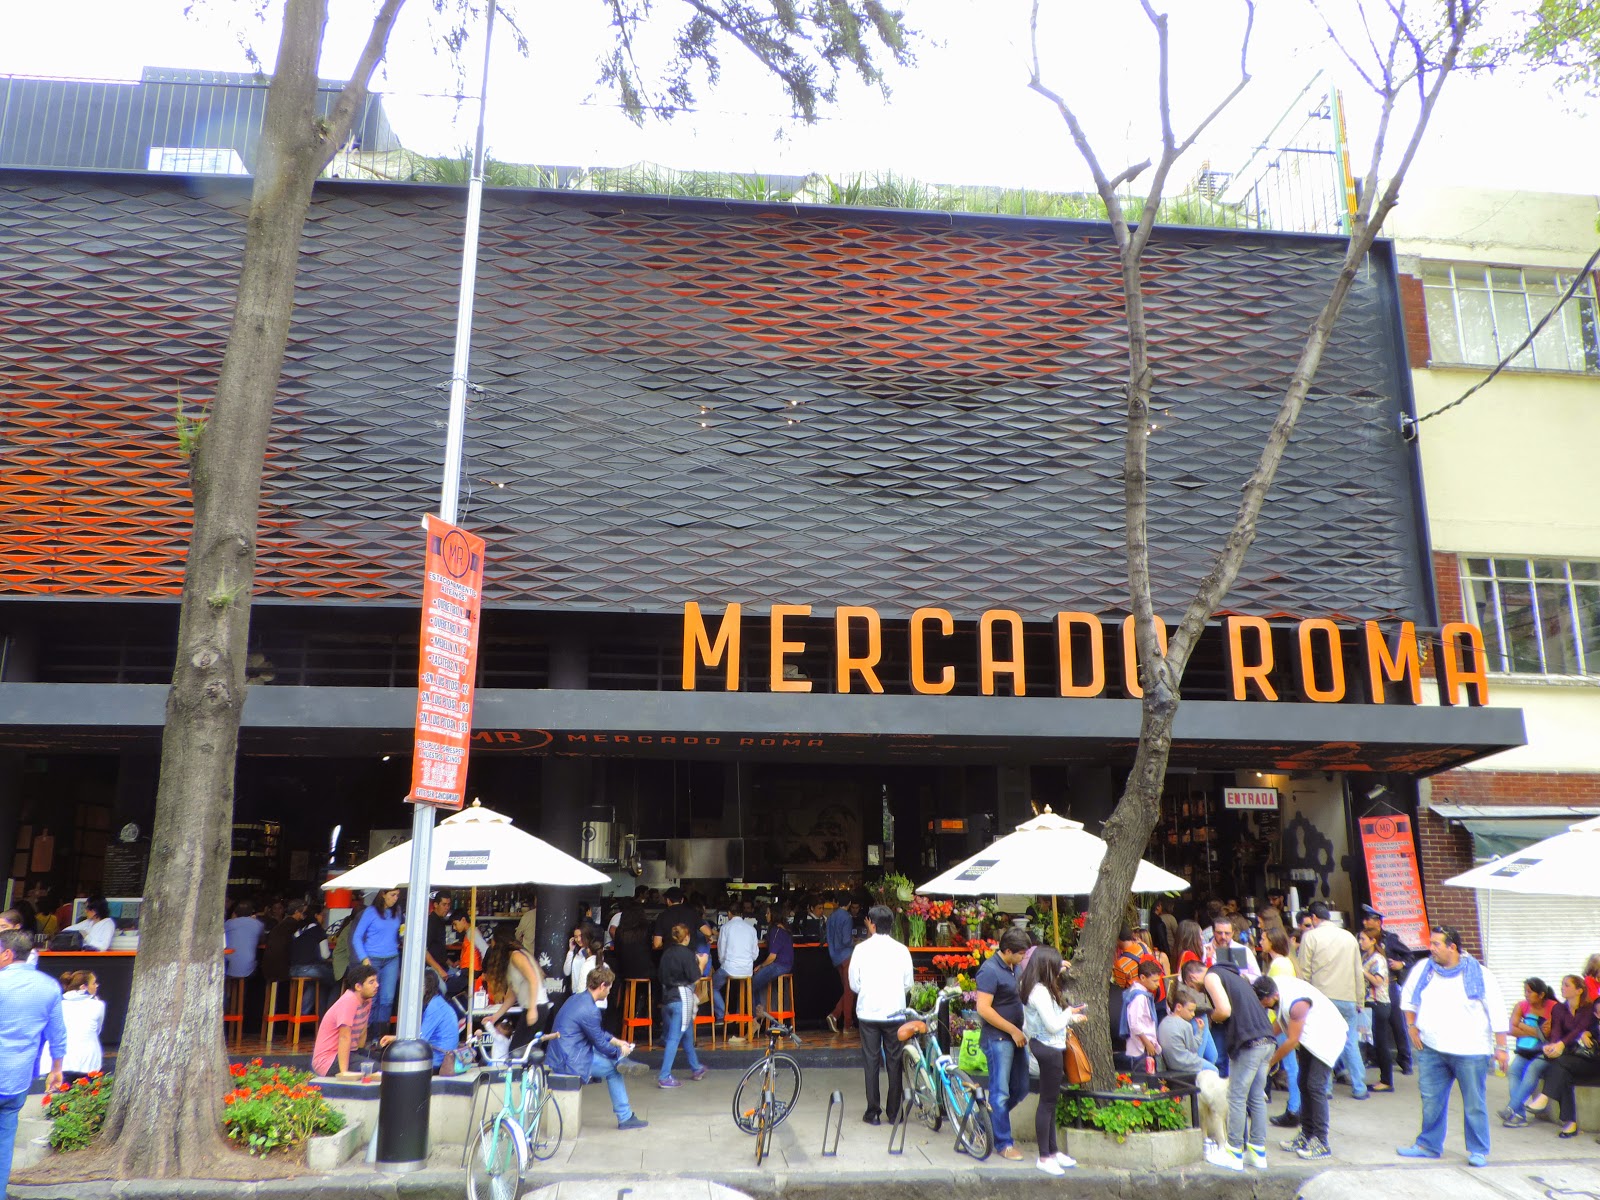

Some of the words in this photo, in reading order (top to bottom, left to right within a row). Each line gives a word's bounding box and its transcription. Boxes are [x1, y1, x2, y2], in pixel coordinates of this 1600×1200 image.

[449, 542, 464, 566] MR
[682, 601, 1168, 700] MERCADO
[1226, 615, 1489, 707] ROMA
[567, 733, 721, 745] MERCADO
[740, 737, 824, 747] ROMA
[1227, 792, 1275, 805] ENTRADA
